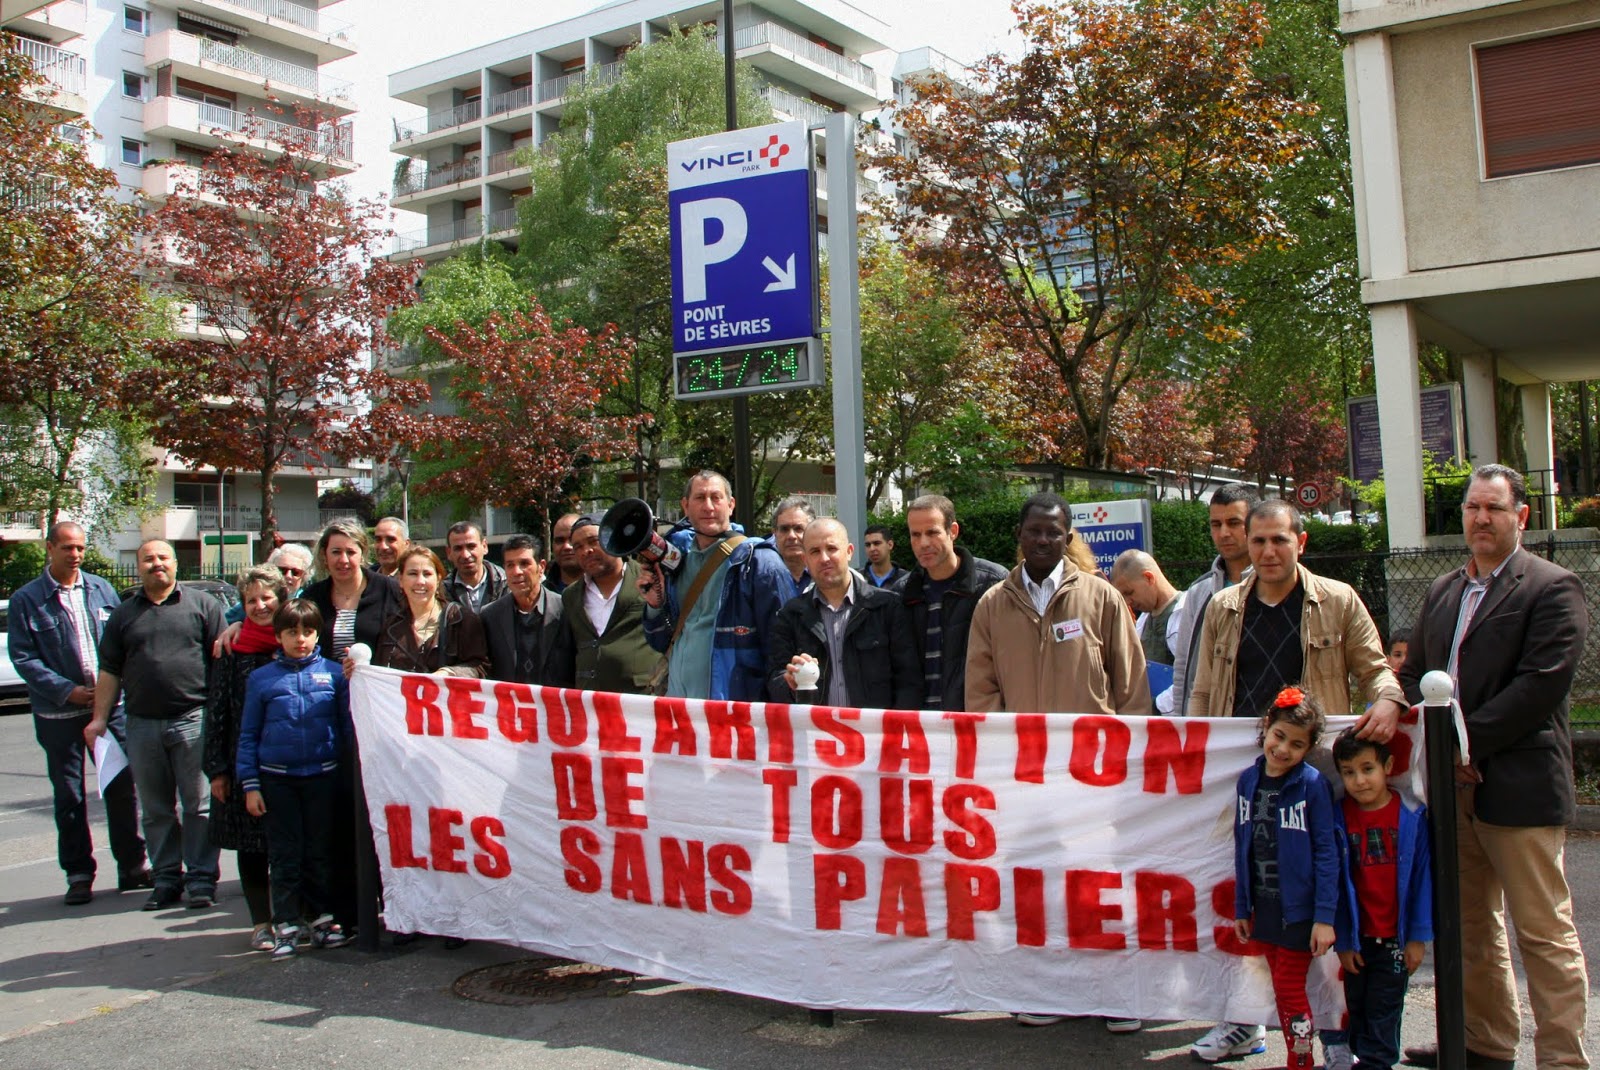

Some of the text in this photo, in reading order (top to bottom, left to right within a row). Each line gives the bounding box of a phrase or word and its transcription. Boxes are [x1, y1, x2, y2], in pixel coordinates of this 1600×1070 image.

[681, 150, 752, 172] VINCI
[742, 164, 761, 173] PARK
[680, 197, 748, 304] P
[683, 305, 725, 324] PONT
[684, 317, 771, 343] DE SÈVRES
[1302, 489, 1317, 500] 30
[400, 675, 1210, 794] REGULARISATION
[551, 752, 998, 860] DE TOUS
[384, 804, 512, 878] LES
[560, 825, 752, 915] SANS
